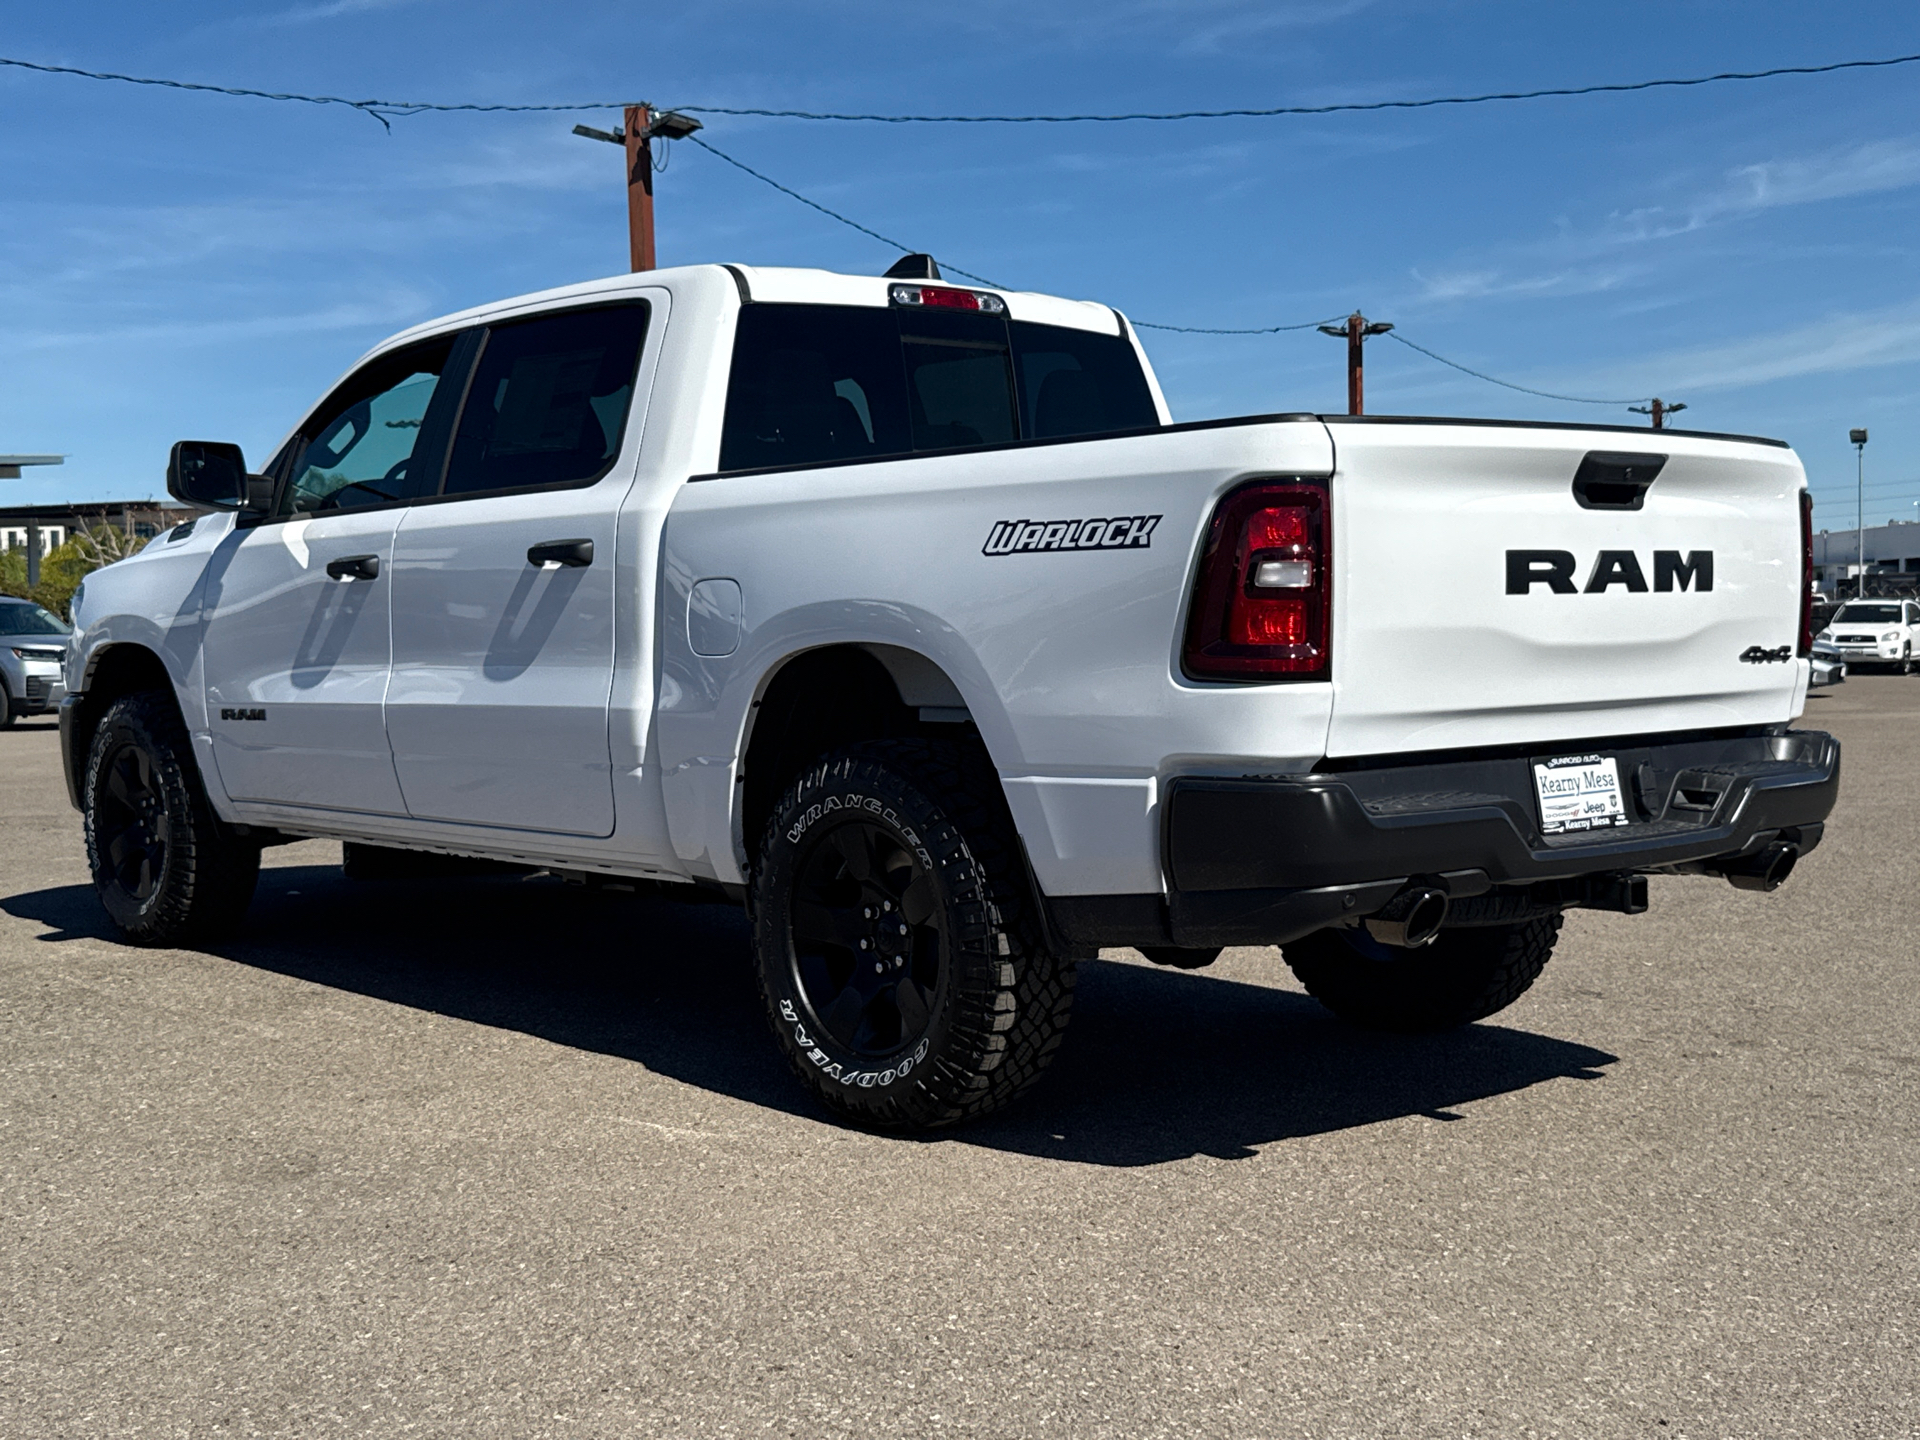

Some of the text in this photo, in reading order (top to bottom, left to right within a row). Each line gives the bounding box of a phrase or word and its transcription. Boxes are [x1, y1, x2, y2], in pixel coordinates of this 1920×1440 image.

[982, 515, 1163, 556] WARLOCK
[1505, 550, 1713, 595] RAM
[1739, 645, 1793, 664] 4x4
[221, 708, 267, 721] RAM
[1539, 770, 1615, 796] Kearny Mesa
[1583, 801, 1606, 814] Jeep
[787, 794, 935, 871] WRANGLER
[1564, 819, 1590, 830] Kearny
[1591, 816, 1610, 827] Mesa
[780, 999, 930, 1087] GOODYEAR
